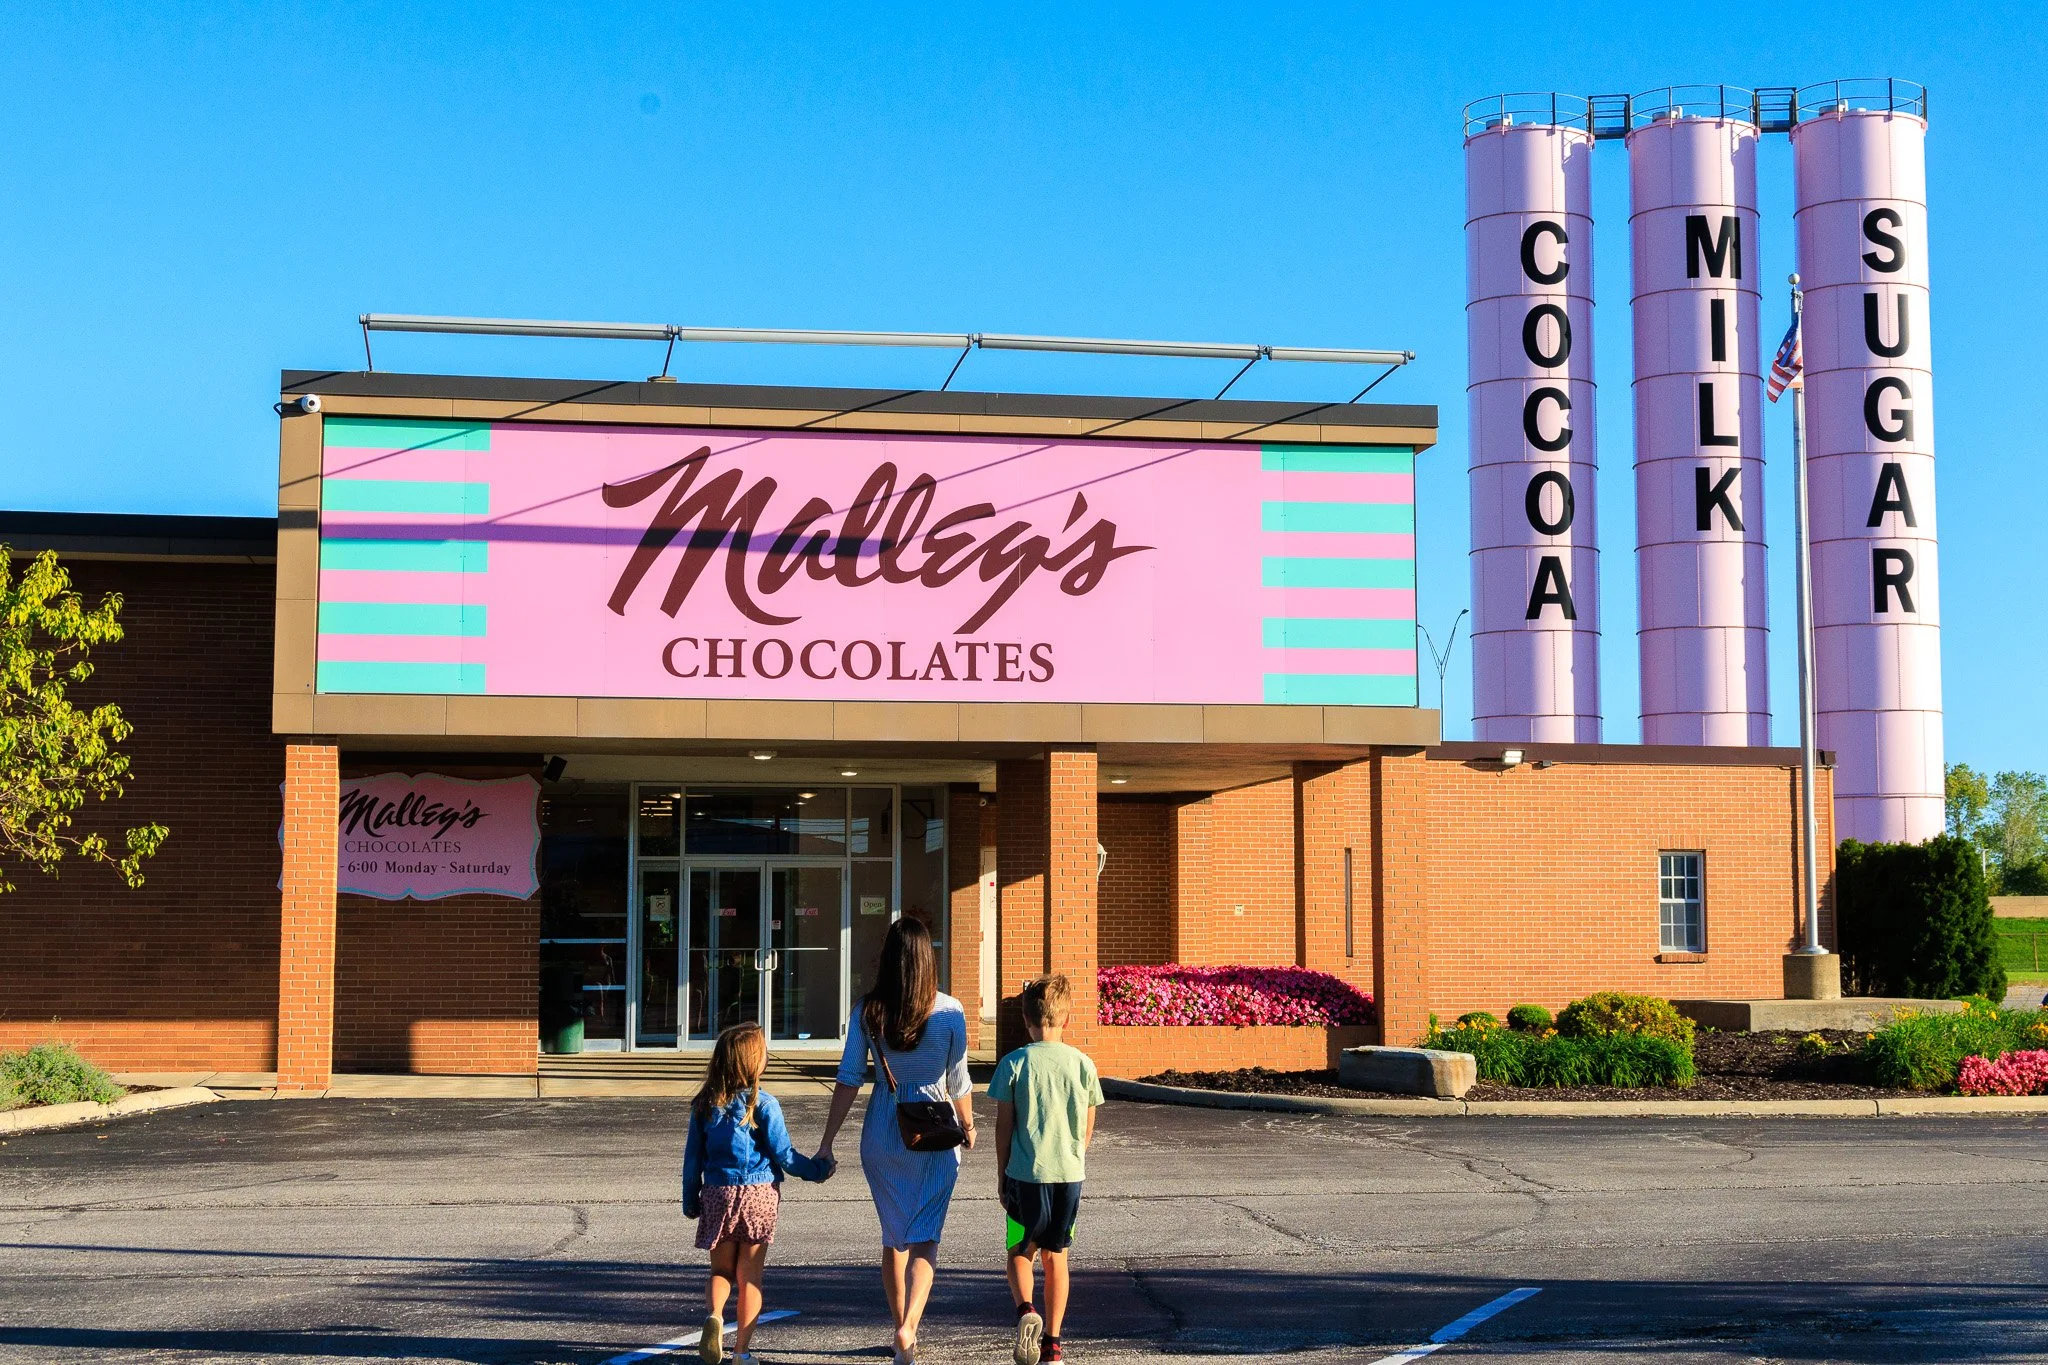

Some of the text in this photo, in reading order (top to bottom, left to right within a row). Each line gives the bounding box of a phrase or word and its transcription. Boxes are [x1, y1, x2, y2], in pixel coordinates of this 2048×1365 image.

[1520, 221, 1578, 621] COCOA
[1685, 215, 1745, 532] MILK
[1861, 208, 1917, 614] SUGAR
[602, 446, 1157, 635] Malley's
[662, 637, 1055, 682] CHOCOLATES
[344, 840, 461, 853] CHOCOLATES
[347, 861, 378, 873] 6:00
[385, 861, 437, 875] Monday
[449, 861, 511, 875] Saturday
[863, 901, 882, 909] Open
